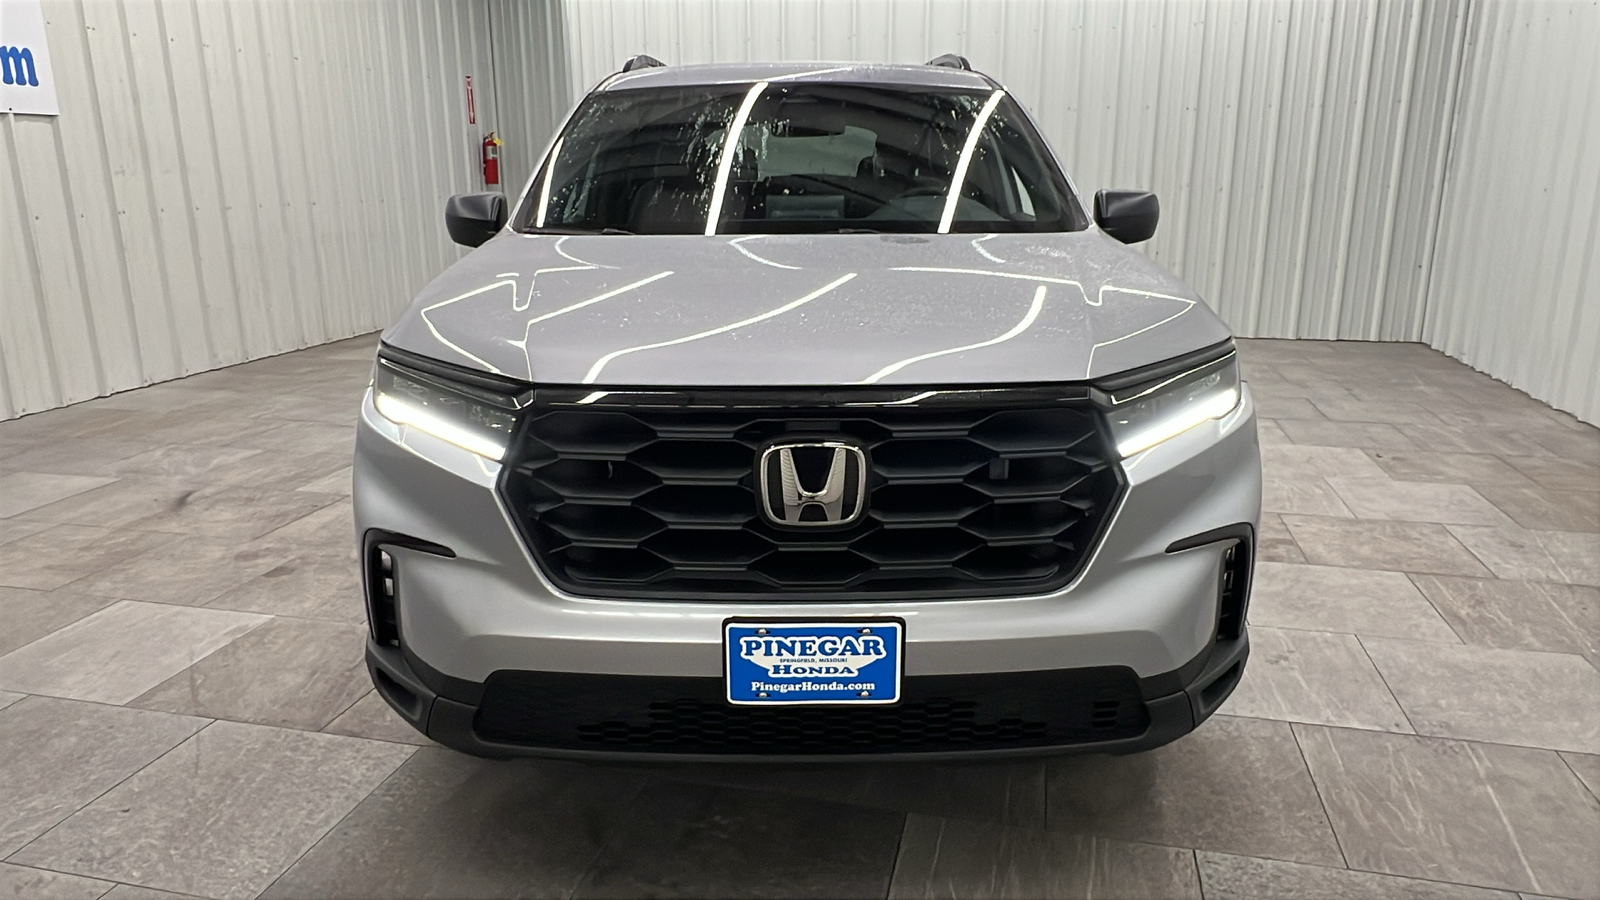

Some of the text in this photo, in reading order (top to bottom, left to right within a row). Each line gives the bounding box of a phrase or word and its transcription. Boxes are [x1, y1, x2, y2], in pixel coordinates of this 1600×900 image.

[743, 638, 883, 657] PINEGAR
[772, 665, 855, 675] HONDA
[751, 681, 876, 693] PinegarHonda.com
